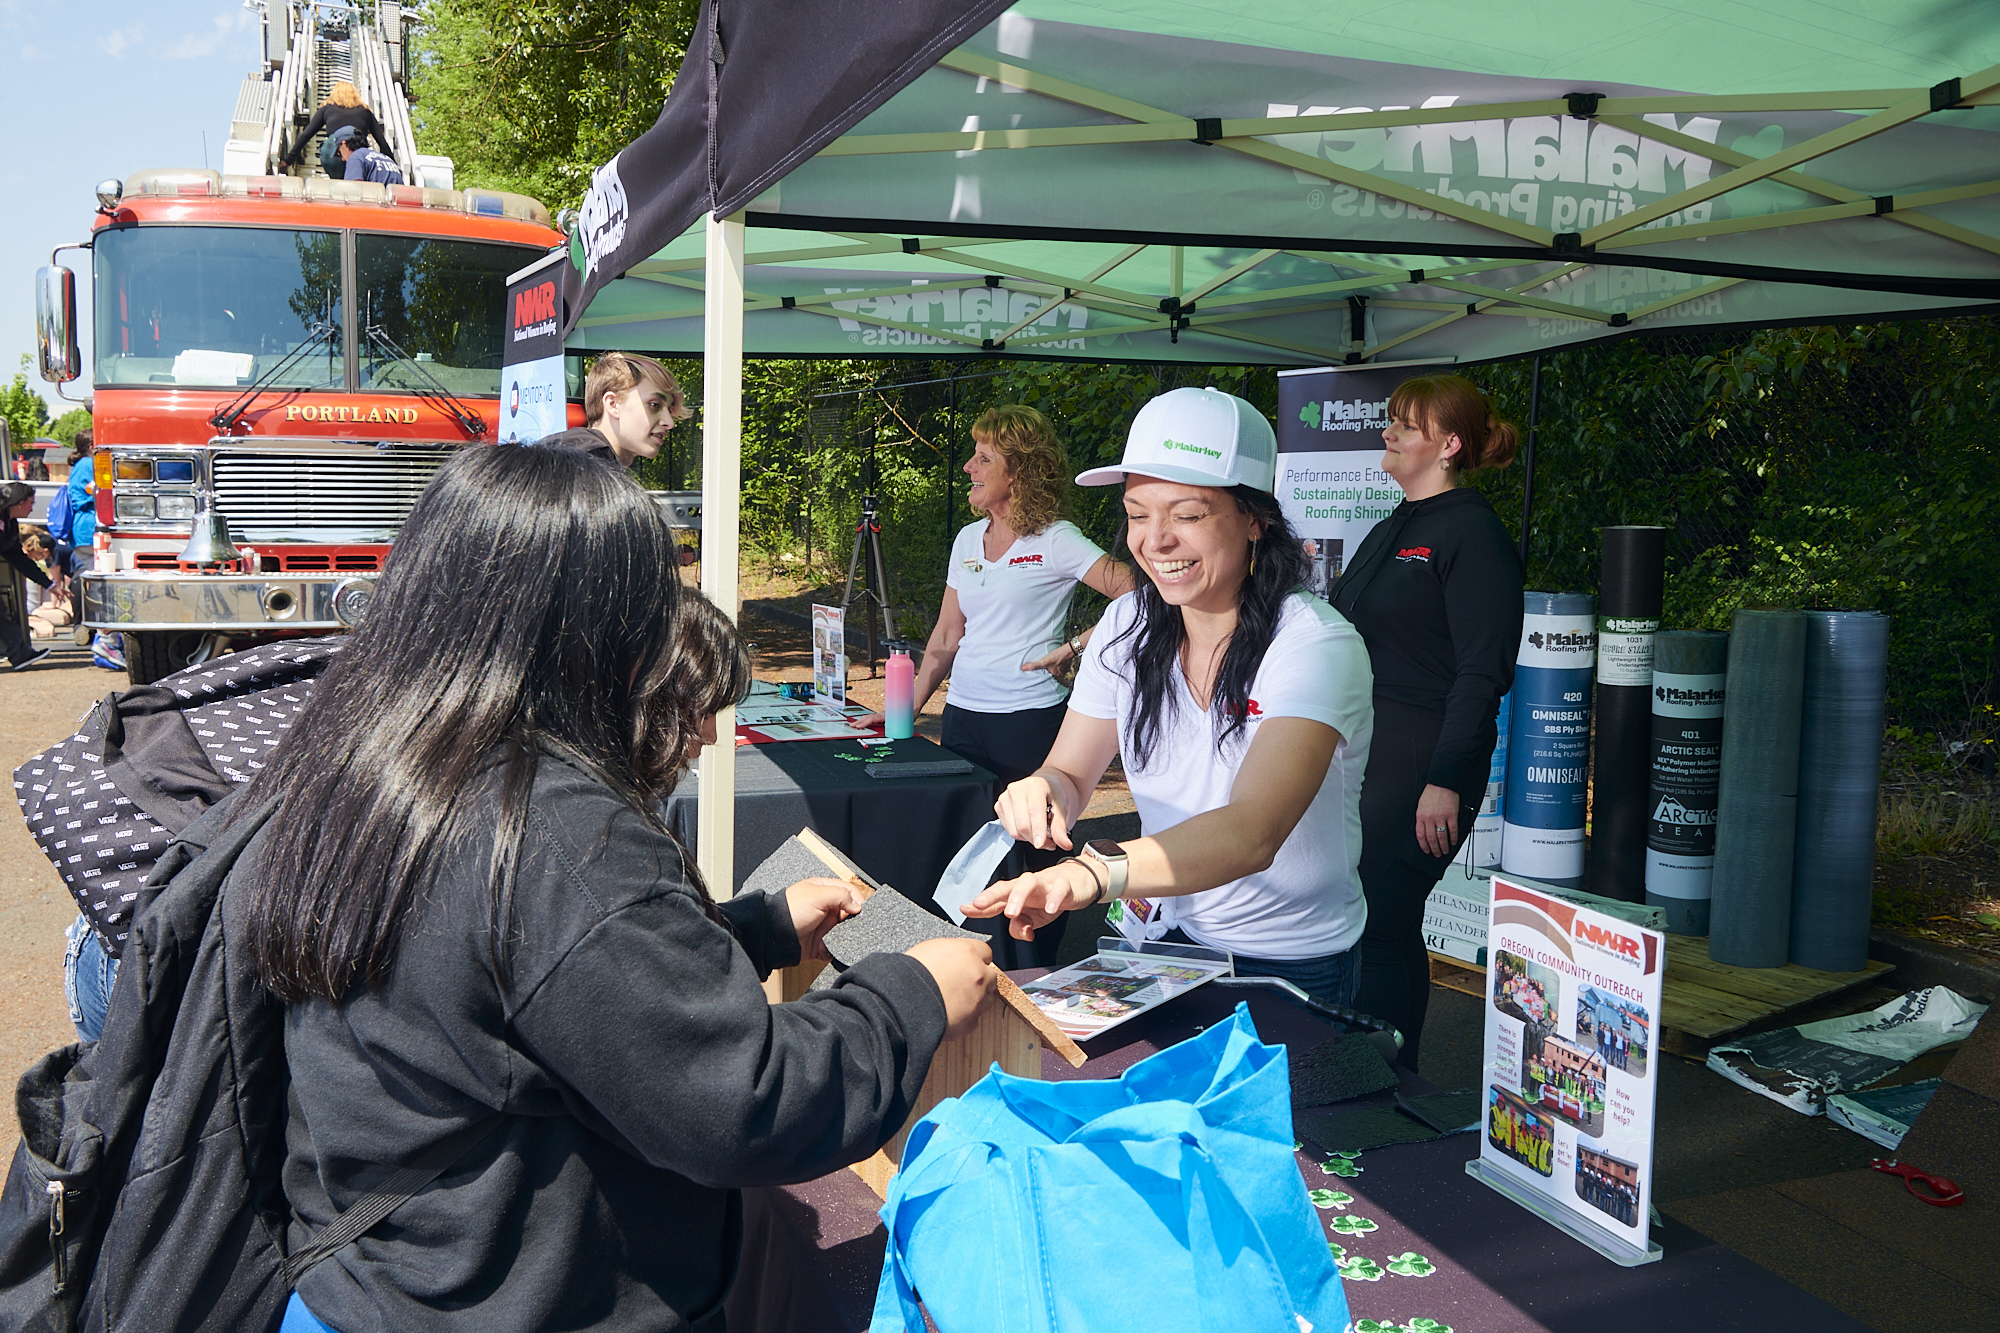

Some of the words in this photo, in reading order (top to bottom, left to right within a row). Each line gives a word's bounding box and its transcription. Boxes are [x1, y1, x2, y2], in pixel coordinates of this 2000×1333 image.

[520, 384, 552, 405] MENTORING
[285, 405, 418, 424] PORTLAND
[1322, 420, 1361, 432] Roofing
[1174, 441, 1222, 459] Malarkey
[1286, 468, 1361, 482] Performance
[1293, 487, 1362, 503] Sustainably
[1305, 506, 1351, 522] Roofing
[1616, 619, 1660, 628] Malarkey
[1563, 692, 1582, 702] 420
[1544, 725, 1561, 733] SBS
[1563, 726, 1574, 735] Ply
[1681, 731, 1700, 739] 401
[1661, 745, 1693, 755] ARCTIC
[82, 752, 100, 762] VANS
[1670, 759, 1696, 767] Polymer
[1652, 763, 1688, 775] Self-Adhering
[232, 774, 250, 783] VANS
[55, 806, 70, 815] VANS
[83, 801, 98, 810] VANS
[67, 820, 82, 829] VANS
[98, 815, 117, 825] VANS
[81, 835, 98, 843] VANS
[115, 830, 133, 838] VANS
[97, 848, 114, 857] VANS
[131, 843, 149, 852] VANS
[68, 854, 82, 863] VANS
[118, 862, 137, 871] VANS
[83, 868, 101, 878] VANS
[102, 880, 120, 890] VANS
[1427, 934, 1450, 950] RT
[1574, 938, 1595, 951] National
[1597, 945, 1614, 958] Women
[1621, 953, 1641, 968] Roofing
[1501, 937, 1534, 959] OREGON
[1537, 951, 1592, 982] COMMUNITY
[1595, 974, 1643, 1003] OUTREACH
[1499, 1024, 1511, 1035] There
[1498, 1035, 1516, 1049] nothing
[1497, 1044, 1516, 1057] stronger
[1497, 1053, 1507, 1061] than
[1494, 1071, 1517, 1087] volunteer!
[1616, 1088, 1630, 1101] How
[1610, 1099, 1621, 1110] can
[1622, 1105, 1635, 1116] you
[1613, 1111, 1631, 1126] help?
[1558, 1139, 1569, 1149] Let's
[1557, 1149, 1566, 1157] get
[1557, 1157, 1570, 1168] done!
